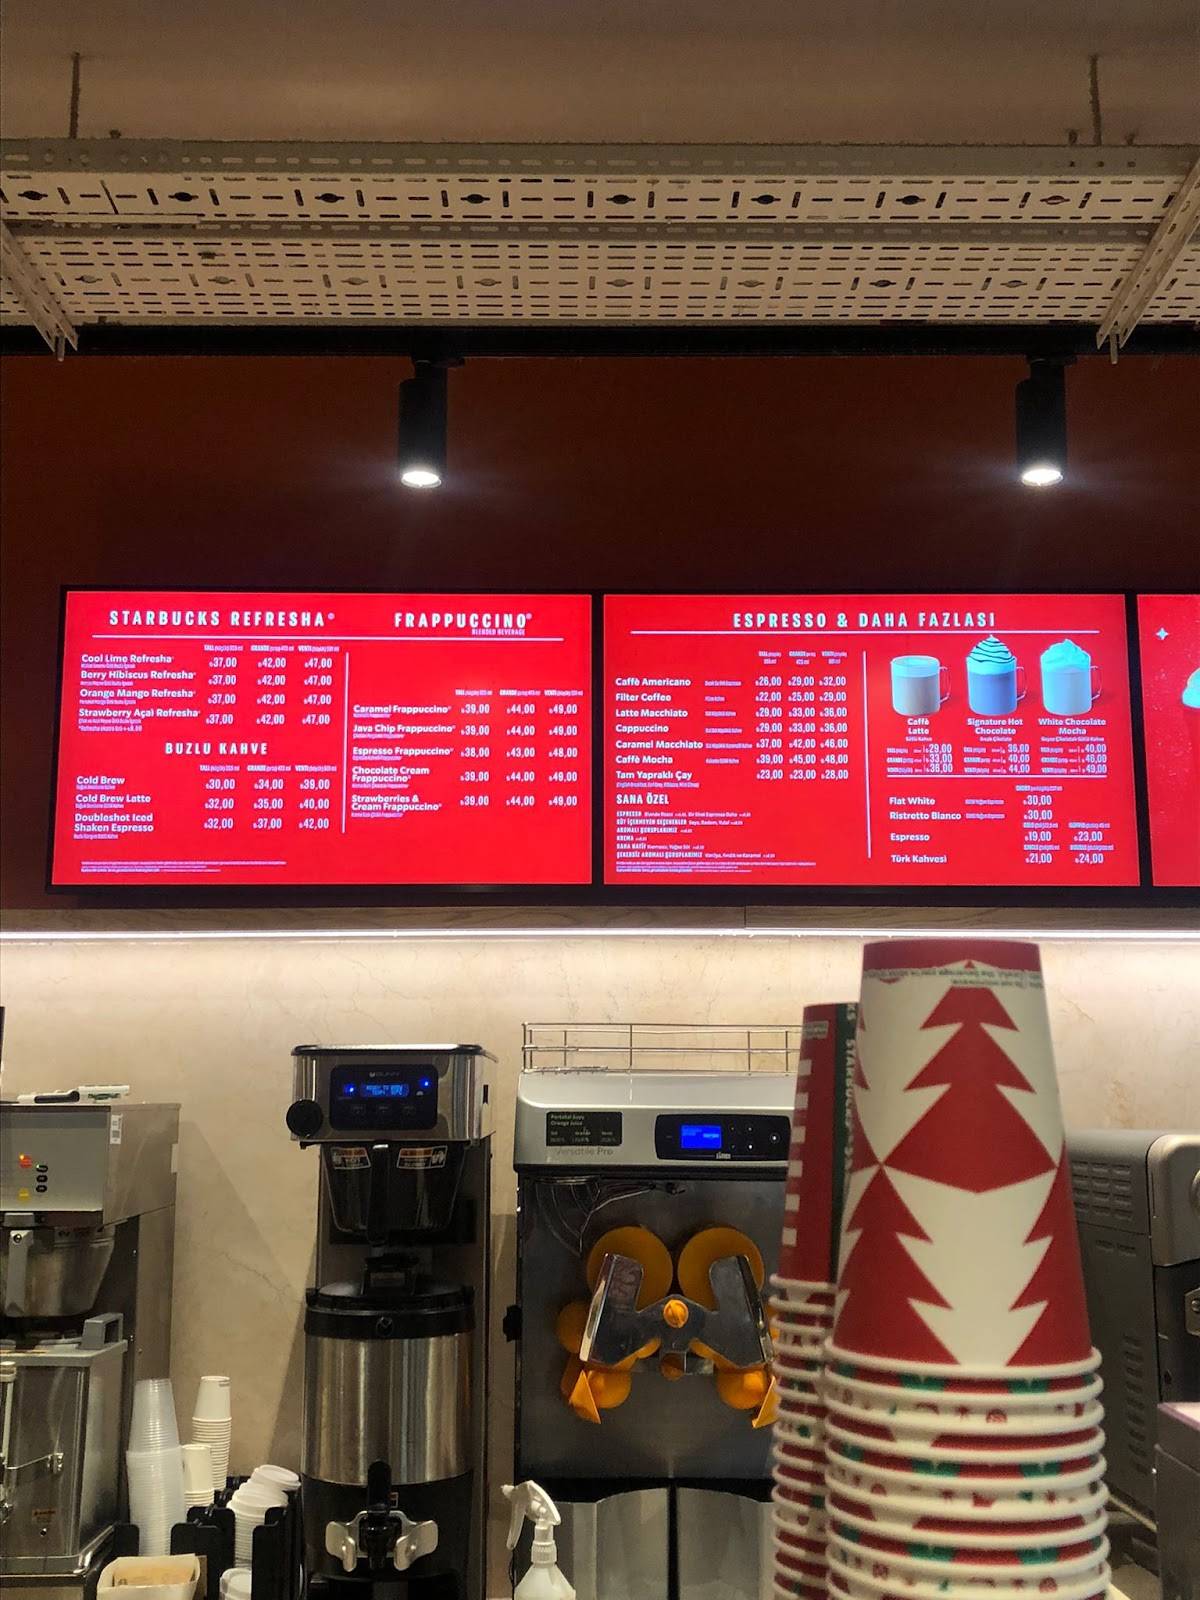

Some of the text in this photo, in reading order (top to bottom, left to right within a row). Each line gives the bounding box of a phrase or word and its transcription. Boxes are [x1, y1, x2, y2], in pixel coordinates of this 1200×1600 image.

[110, 610, 220, 626] STARBUCKS
[732, 612, 994, 628] ESPRESSO & DAHA FAZLASI
[82, 654, 104, 662] Cool
[104, 654, 128, 662] Lime
[80, 670, 106, 680] Berry
[108, 670, 148, 678] Hibiscus
[642, 678, 692, 686] Americano
[80, 688, 114, 700] Orange
[116, 688, 150, 700] Mango
[616, 692, 672, 702] Filter Coffee
[80, 708, 132, 718] Strawberry
[354, 704, 392, 714] Caramel
[616, 708, 688, 718] Latte Macchiato
[968, 718, 1006, 726] Signature
[1038, 718, 1106, 726] White Chocolate
[354, 724, 372, 732] Java
[374, 724, 396, 734] Chip
[616, 724, 668, 734] Cappuccino
[164, 742, 266, 754] BUZLU KAHVE
[616, 740, 704, 748] Caramel Macchiato
[352, 746, 394, 756] Espresso
[642, 756, 674, 764] Mocha
[352, 766, 430, 776] Chocolate Cream
[616, 770, 634, 778] Tam
[676, 770, 692, 780] Çay
[76, 776, 124, 784] Cold Brew
[76, 794, 150, 802] Cold Brew Latte
[352, 794, 410, 804] Strawberries
[616, 792, 670, 804] SANA ÖZEL
[890, 796, 936, 804] Flat White
[352, 802, 382, 810] Cream
[74, 812, 152, 822] Doubleshot Iced
[890, 812, 930, 820] Ristretto
[932, 812, 962, 820] Bianco
[74, 822, 154, 832] Shaken Espresso
[890, 832, 930, 842] Espresso
[890, 854, 946, 862] Türk Kahvesi
